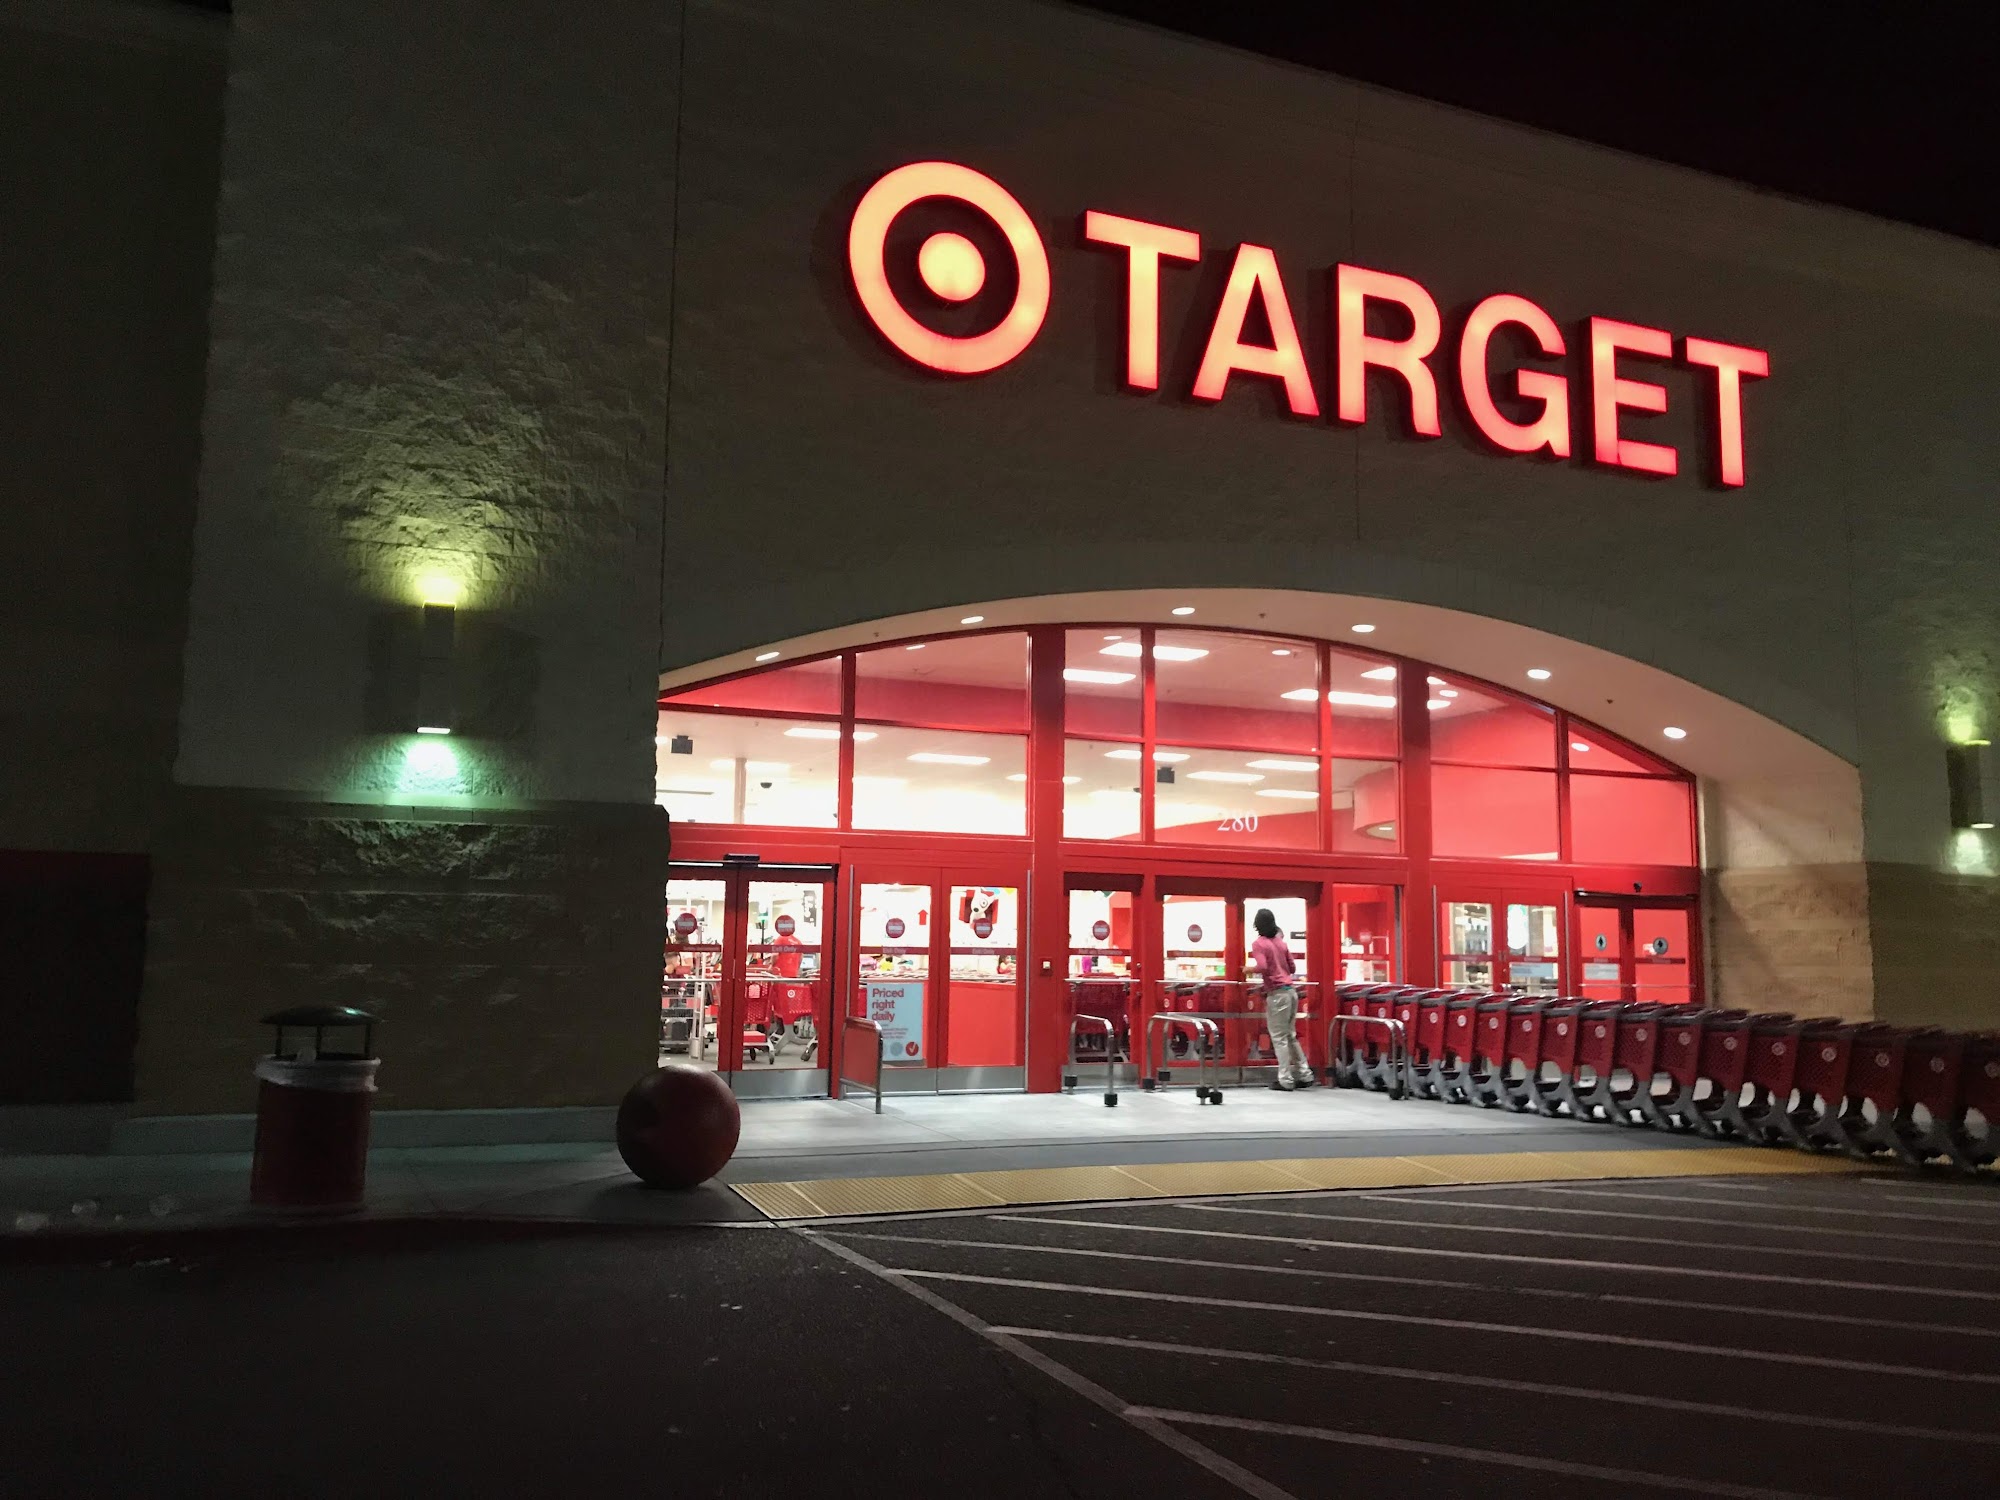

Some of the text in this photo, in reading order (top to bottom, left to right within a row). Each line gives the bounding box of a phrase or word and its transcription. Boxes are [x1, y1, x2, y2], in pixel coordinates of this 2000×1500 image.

[1084, 209, 1770, 488] TARGET
[1216, 809, 1259, 833] 280
[872, 988, 904, 998] Priced
[872, 999, 895, 1011] right
[871, 1011, 895, 1023] daily
